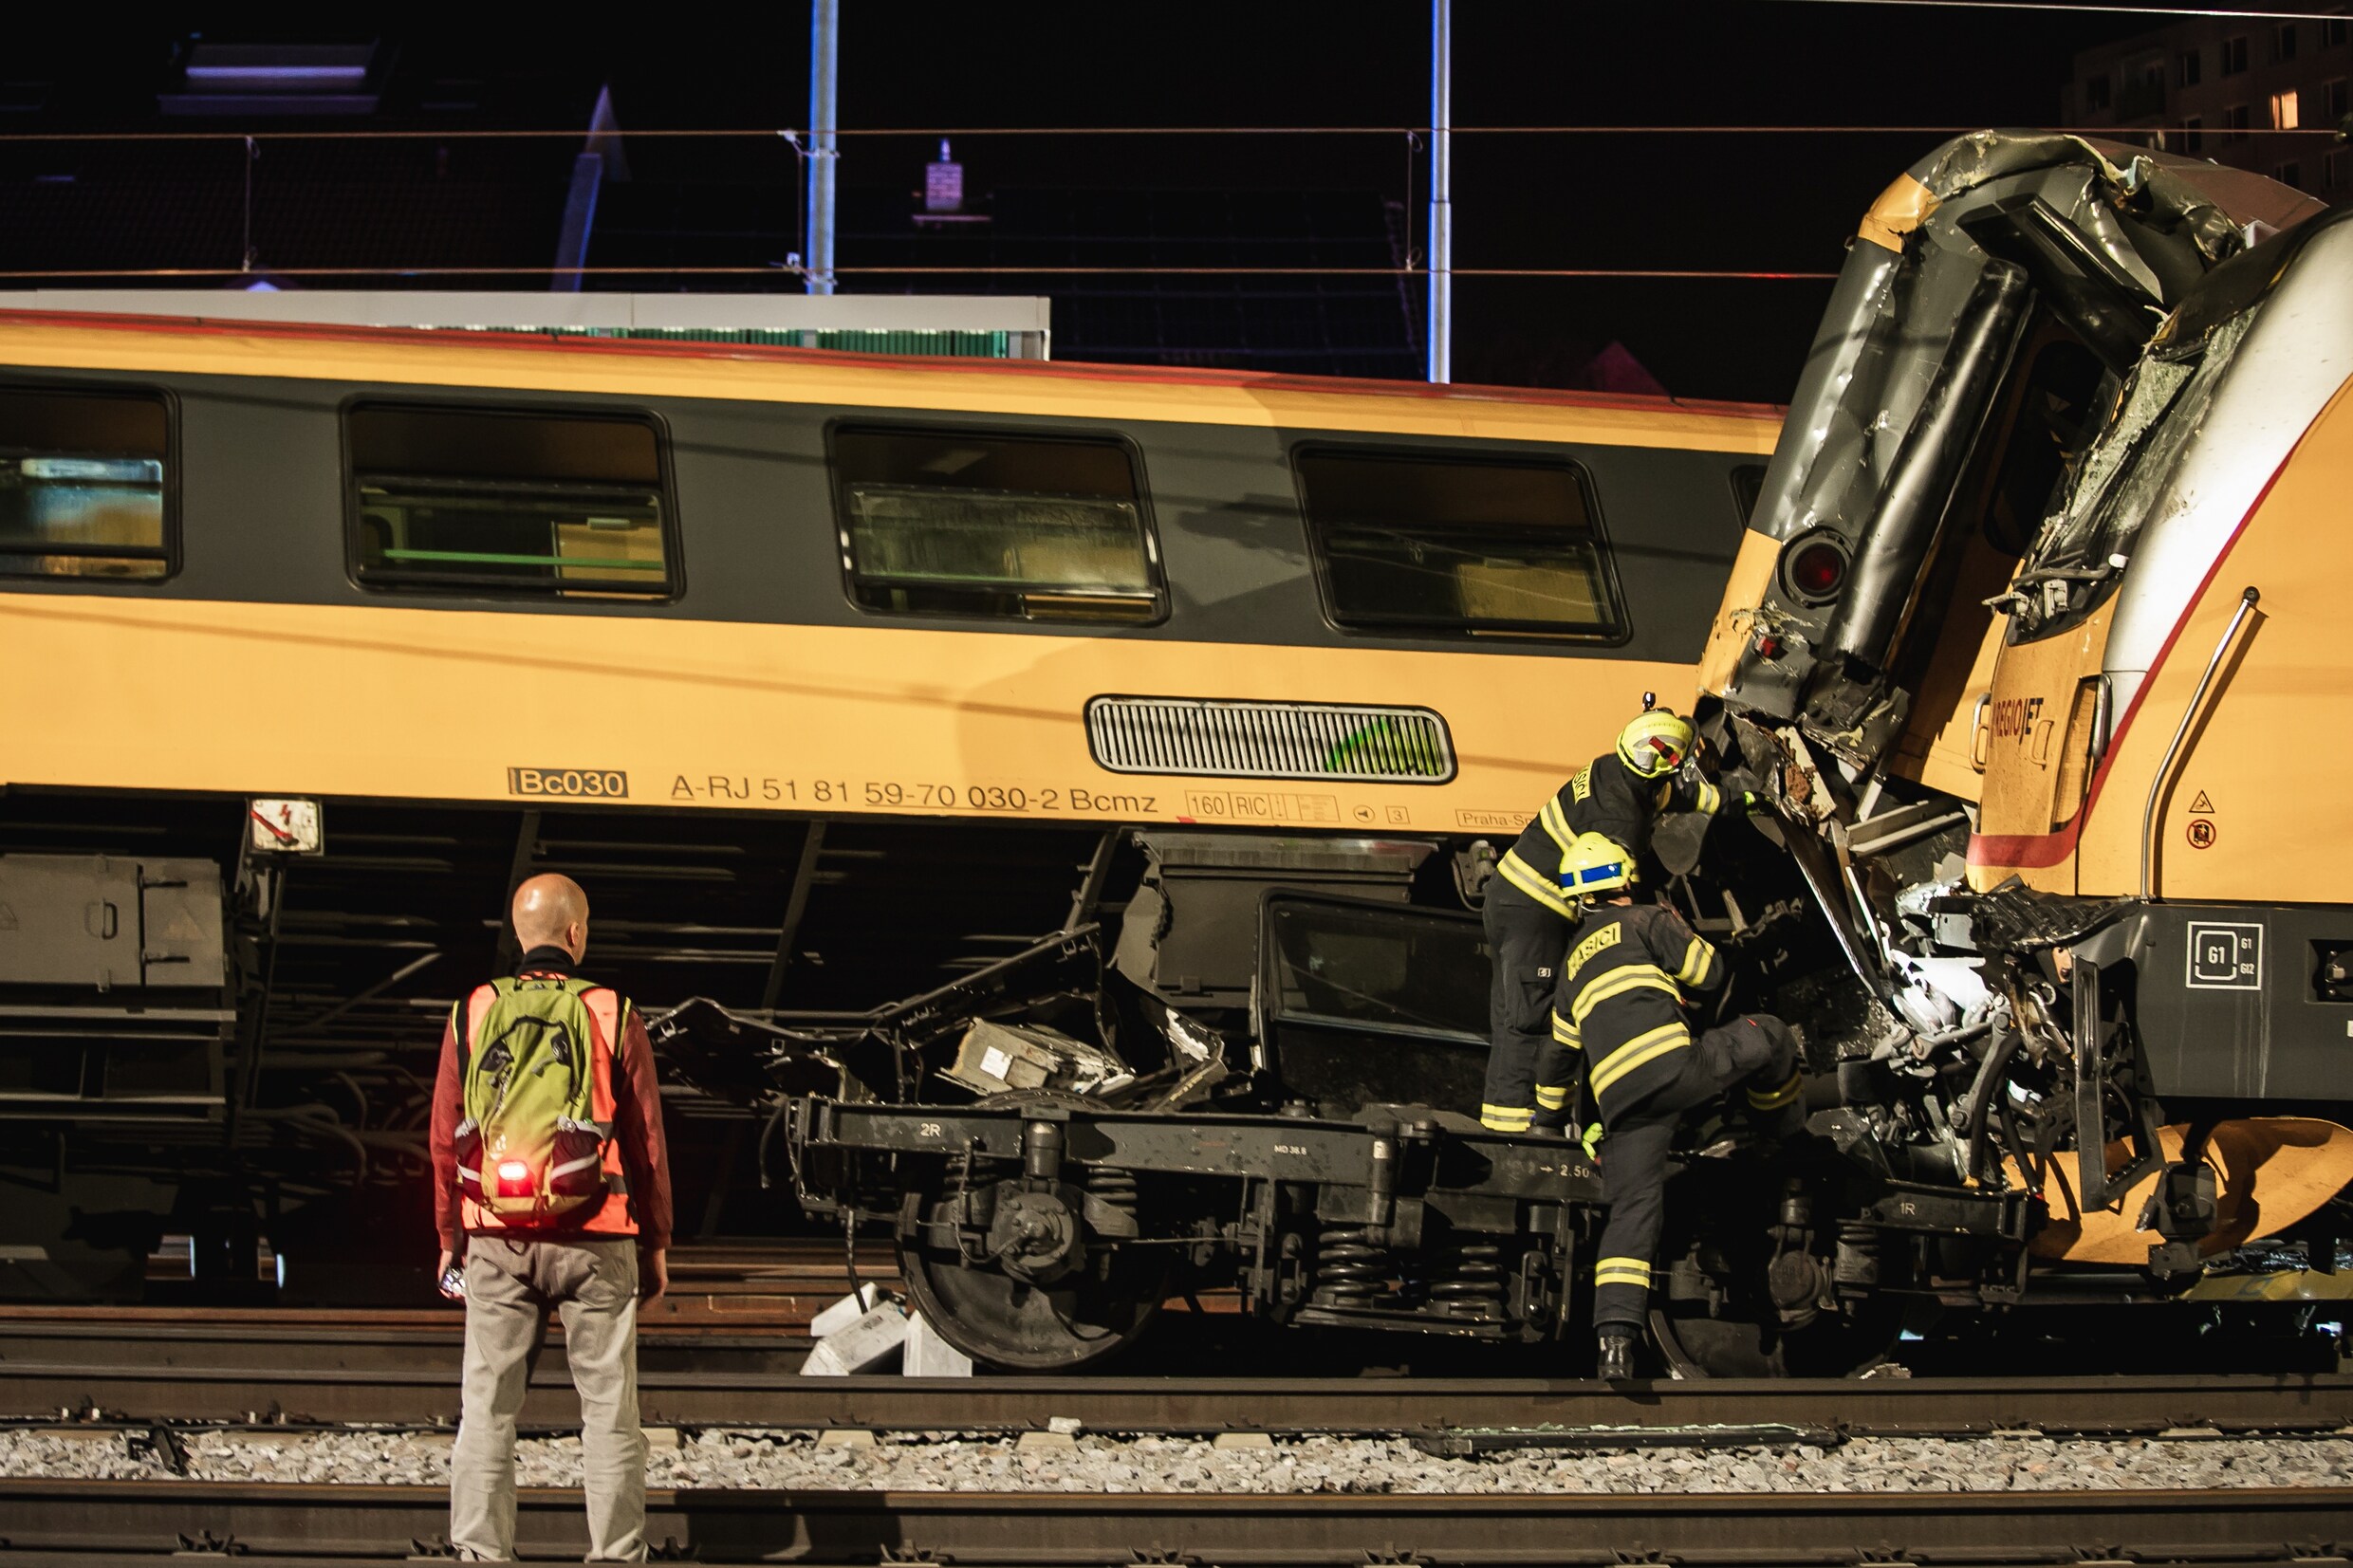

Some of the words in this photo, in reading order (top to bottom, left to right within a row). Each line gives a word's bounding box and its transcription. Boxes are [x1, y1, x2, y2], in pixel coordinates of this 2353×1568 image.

[519, 769, 624, 796] Bc030
[671, 774, 750, 800] A-RJ
[762, 778, 797, 801] 51
[814, 780, 848, 802] 81
[864, 783, 955, 807] 59-70
[968, 785, 1059, 811] 030-2
[1069, 788, 1159, 813] Bcmz
[1191, 795, 1225, 816] 160
[1236, 796, 1268, 817] RIC
[1393, 810, 1402, 821] 3
[919, 1122, 941, 1138] 2R
[1559, 1163, 1590, 1178] 2.50
[1899, 1202, 1916, 1216] 1R
